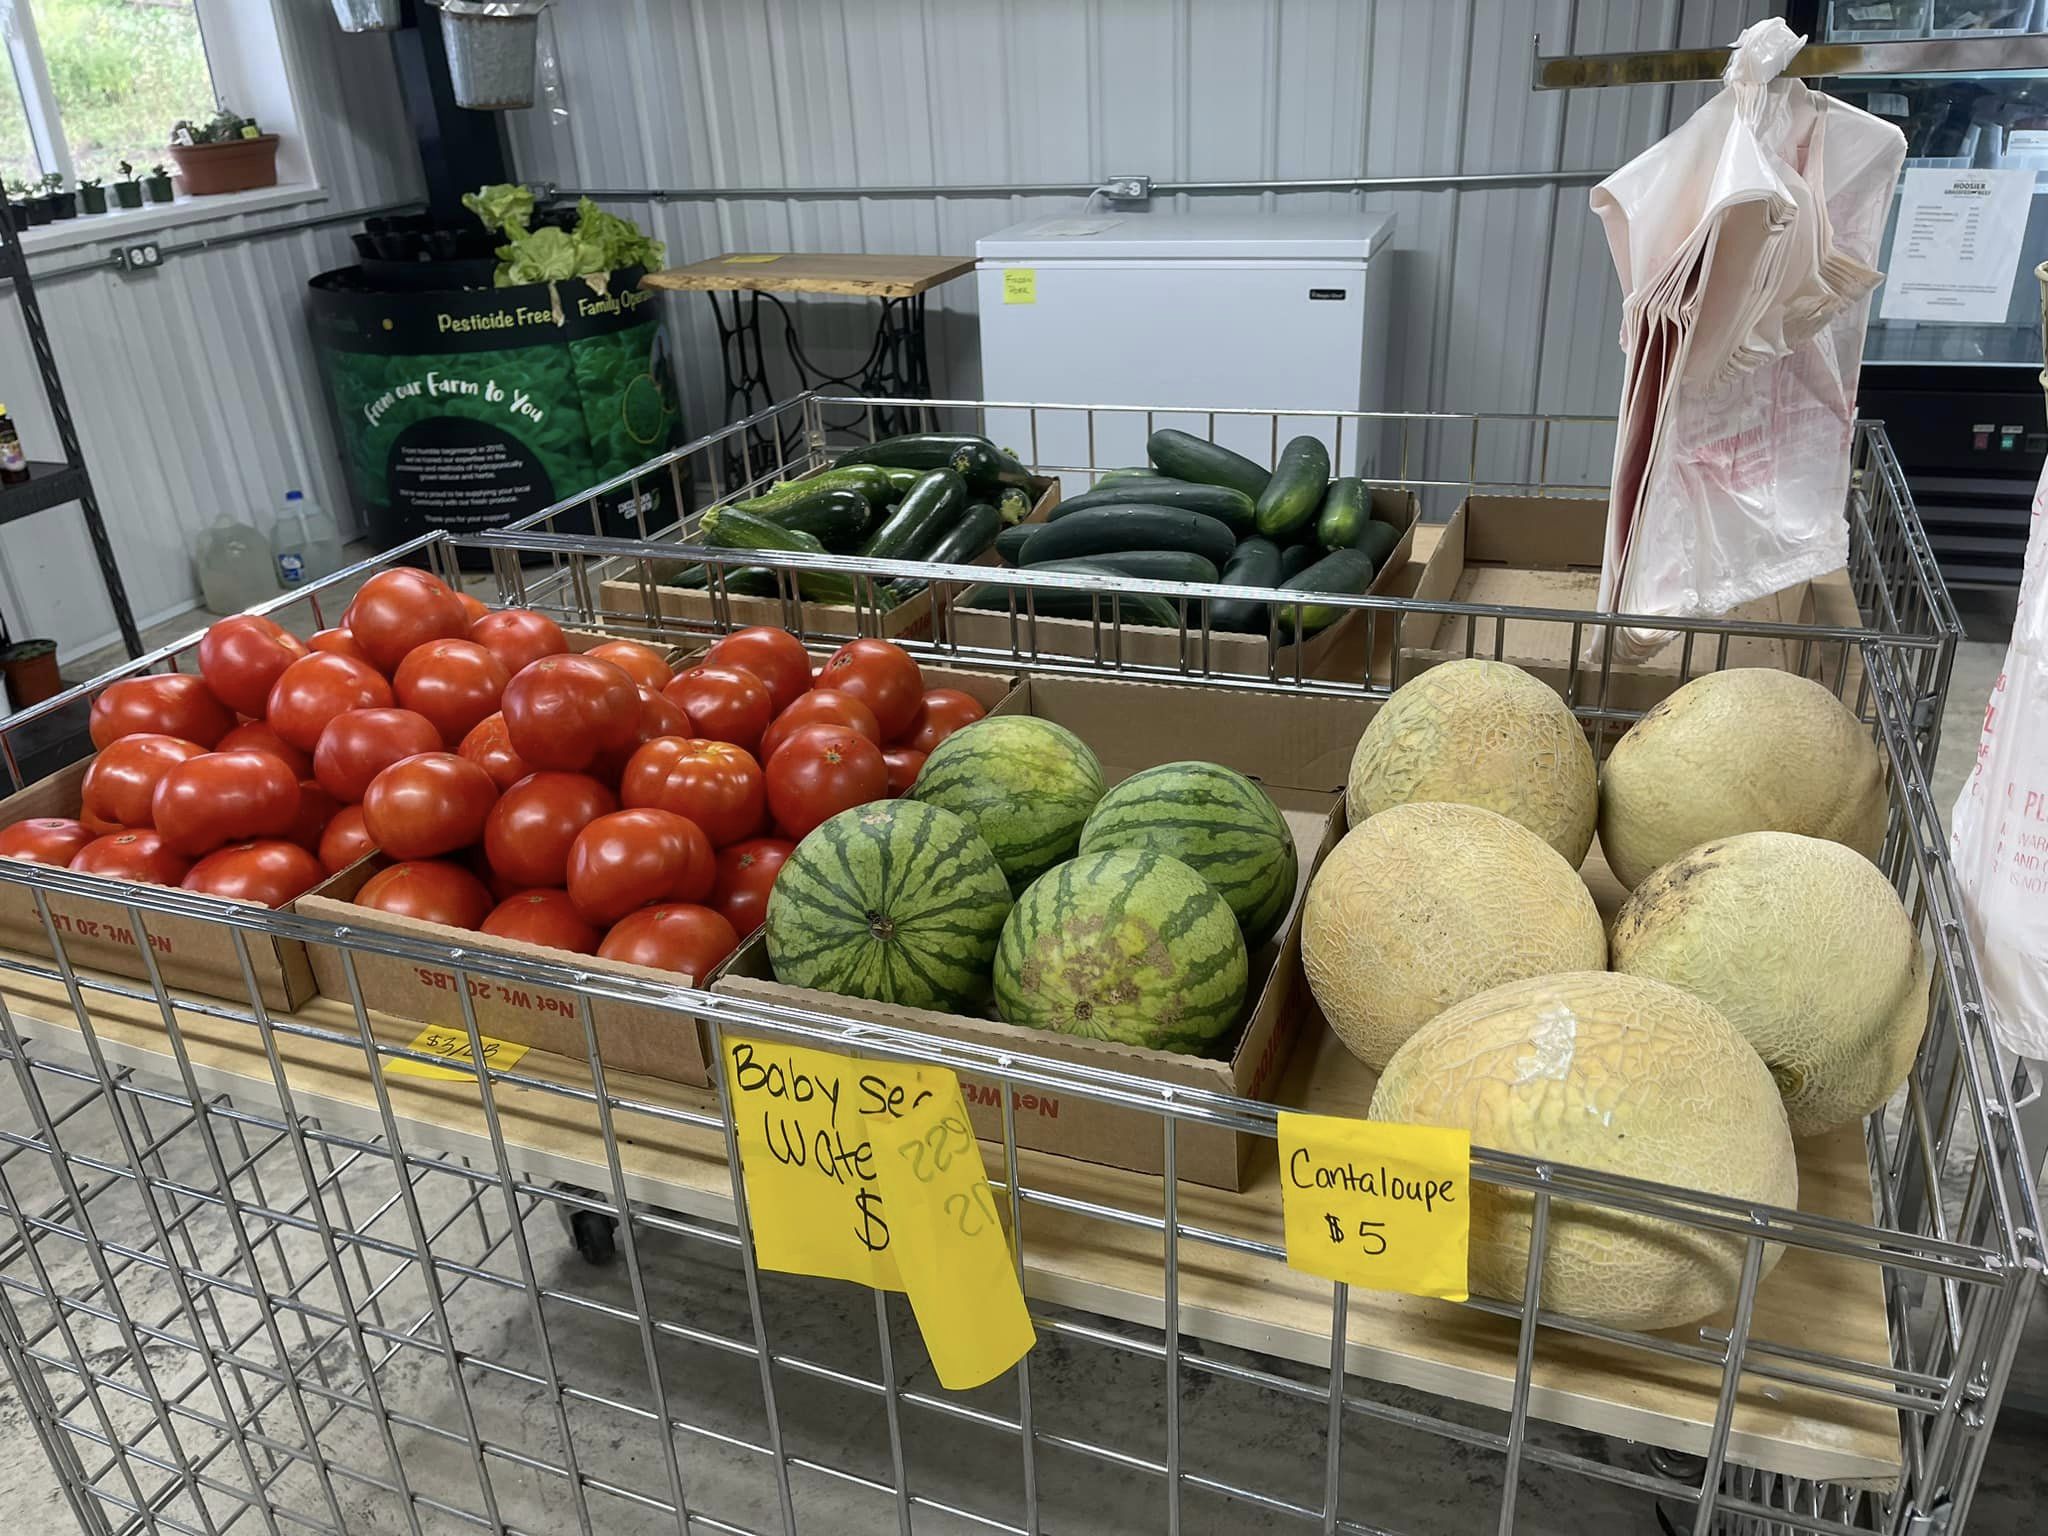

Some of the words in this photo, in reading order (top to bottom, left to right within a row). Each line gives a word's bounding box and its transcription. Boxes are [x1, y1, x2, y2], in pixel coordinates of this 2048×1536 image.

[578, 292, 620, 317] Family
[437, 311, 514, 333] Pesticide
[515, 307, 551, 326] Free
[364, 391, 396, 427] From
[395, 381, 422, 400] our
[426, 371, 479, 397] Farm
[485, 379, 505, 402] to
[510, 389, 545, 423] You
[2024, 791, 2048, 821] PL
[76, 918, 100, 938] 20
[413, 967, 460, 994] LBS.
[469, 979, 492, 999] 20
[535, 996, 575, 1019] Net
[732, 1043, 840, 1129] Baby
[1012, 1091, 1060, 1119] Net
[1290, 1147, 1456, 1213] Cantaloupe
[854, 1187, 891, 1252] $
